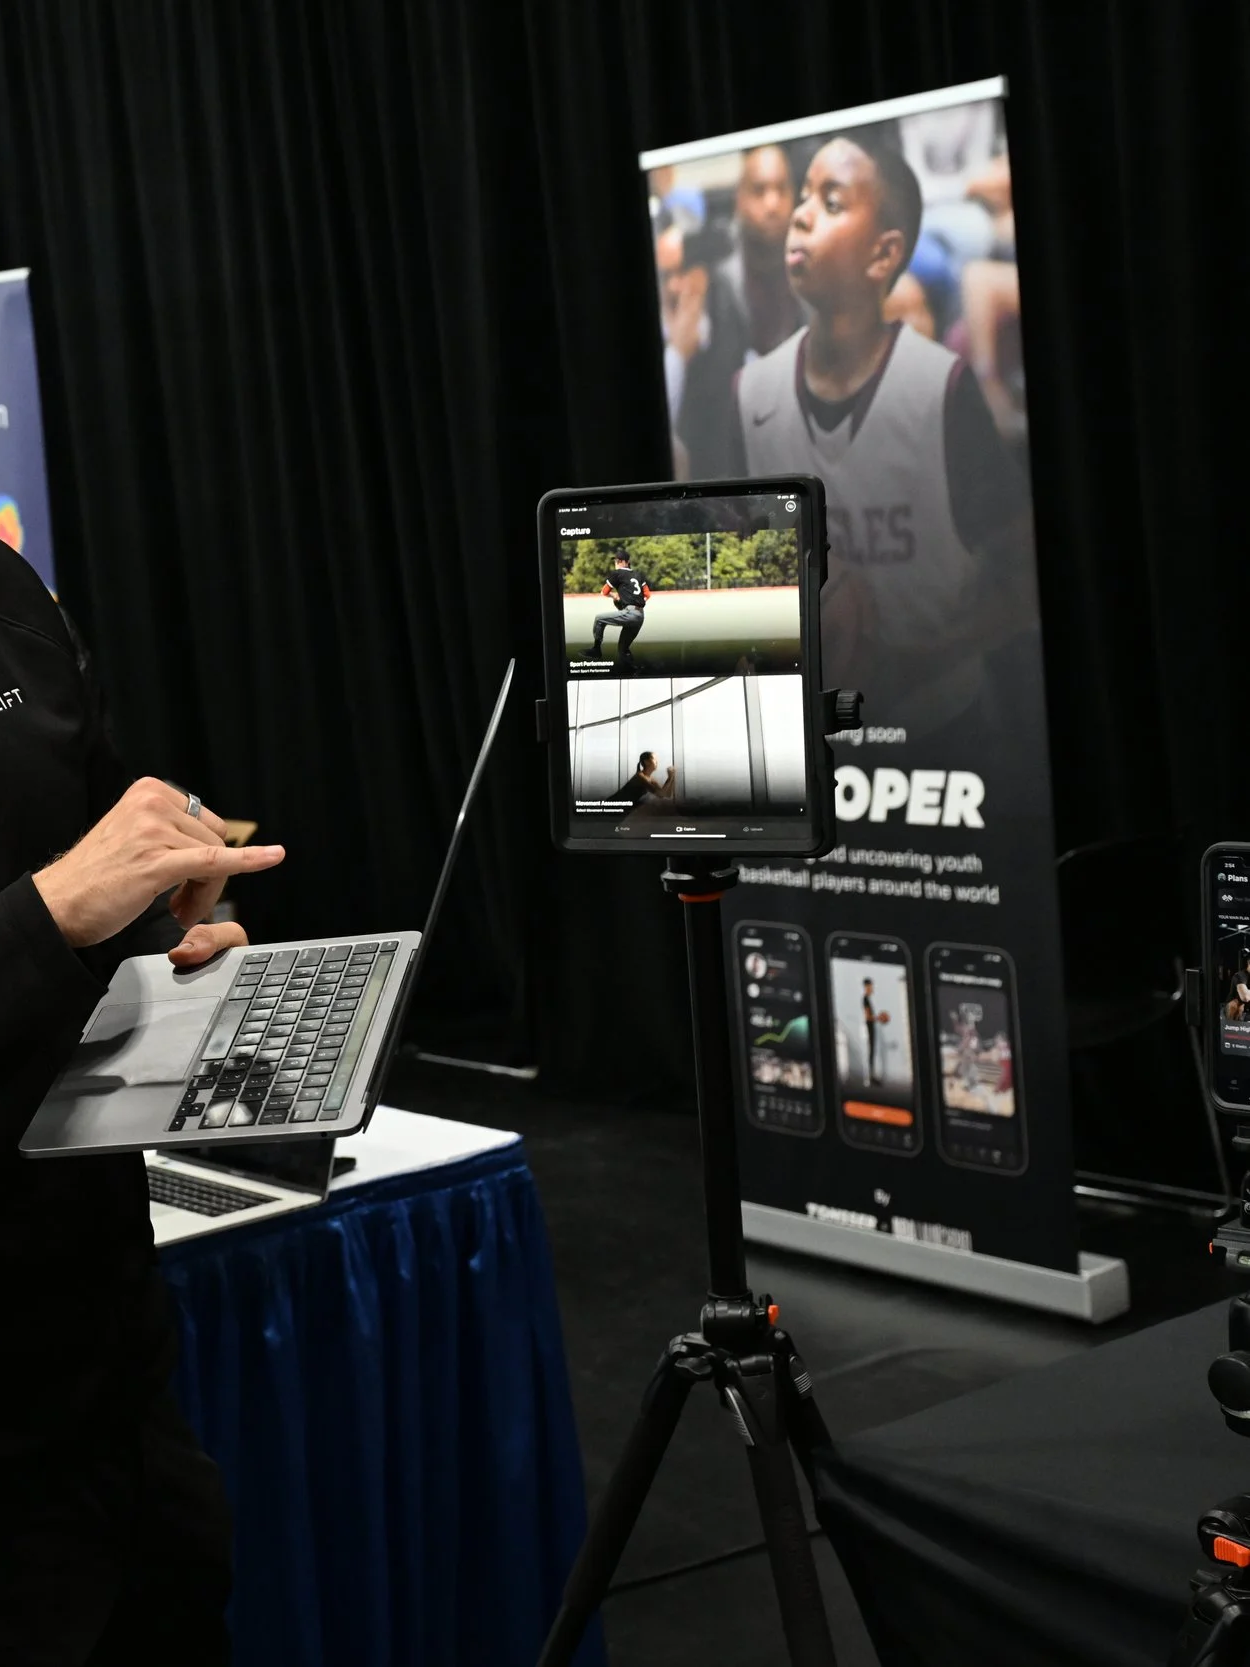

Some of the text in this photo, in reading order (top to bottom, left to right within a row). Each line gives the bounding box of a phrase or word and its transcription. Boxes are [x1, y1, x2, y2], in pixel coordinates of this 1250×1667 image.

[560, 527, 591, 536] Capture
[630, 577, 641, 595] 3
[865, 726, 907, 744] soon
[834, 764, 986, 829] OPER
[849, 848, 933, 875] uncovering
[934, 853, 984, 875] youth
[738, 864, 1000, 905] basketball players around the world
[1227, 874, 1249, 883] Plans
[1224, 1024, 1240, 1032] Jump
